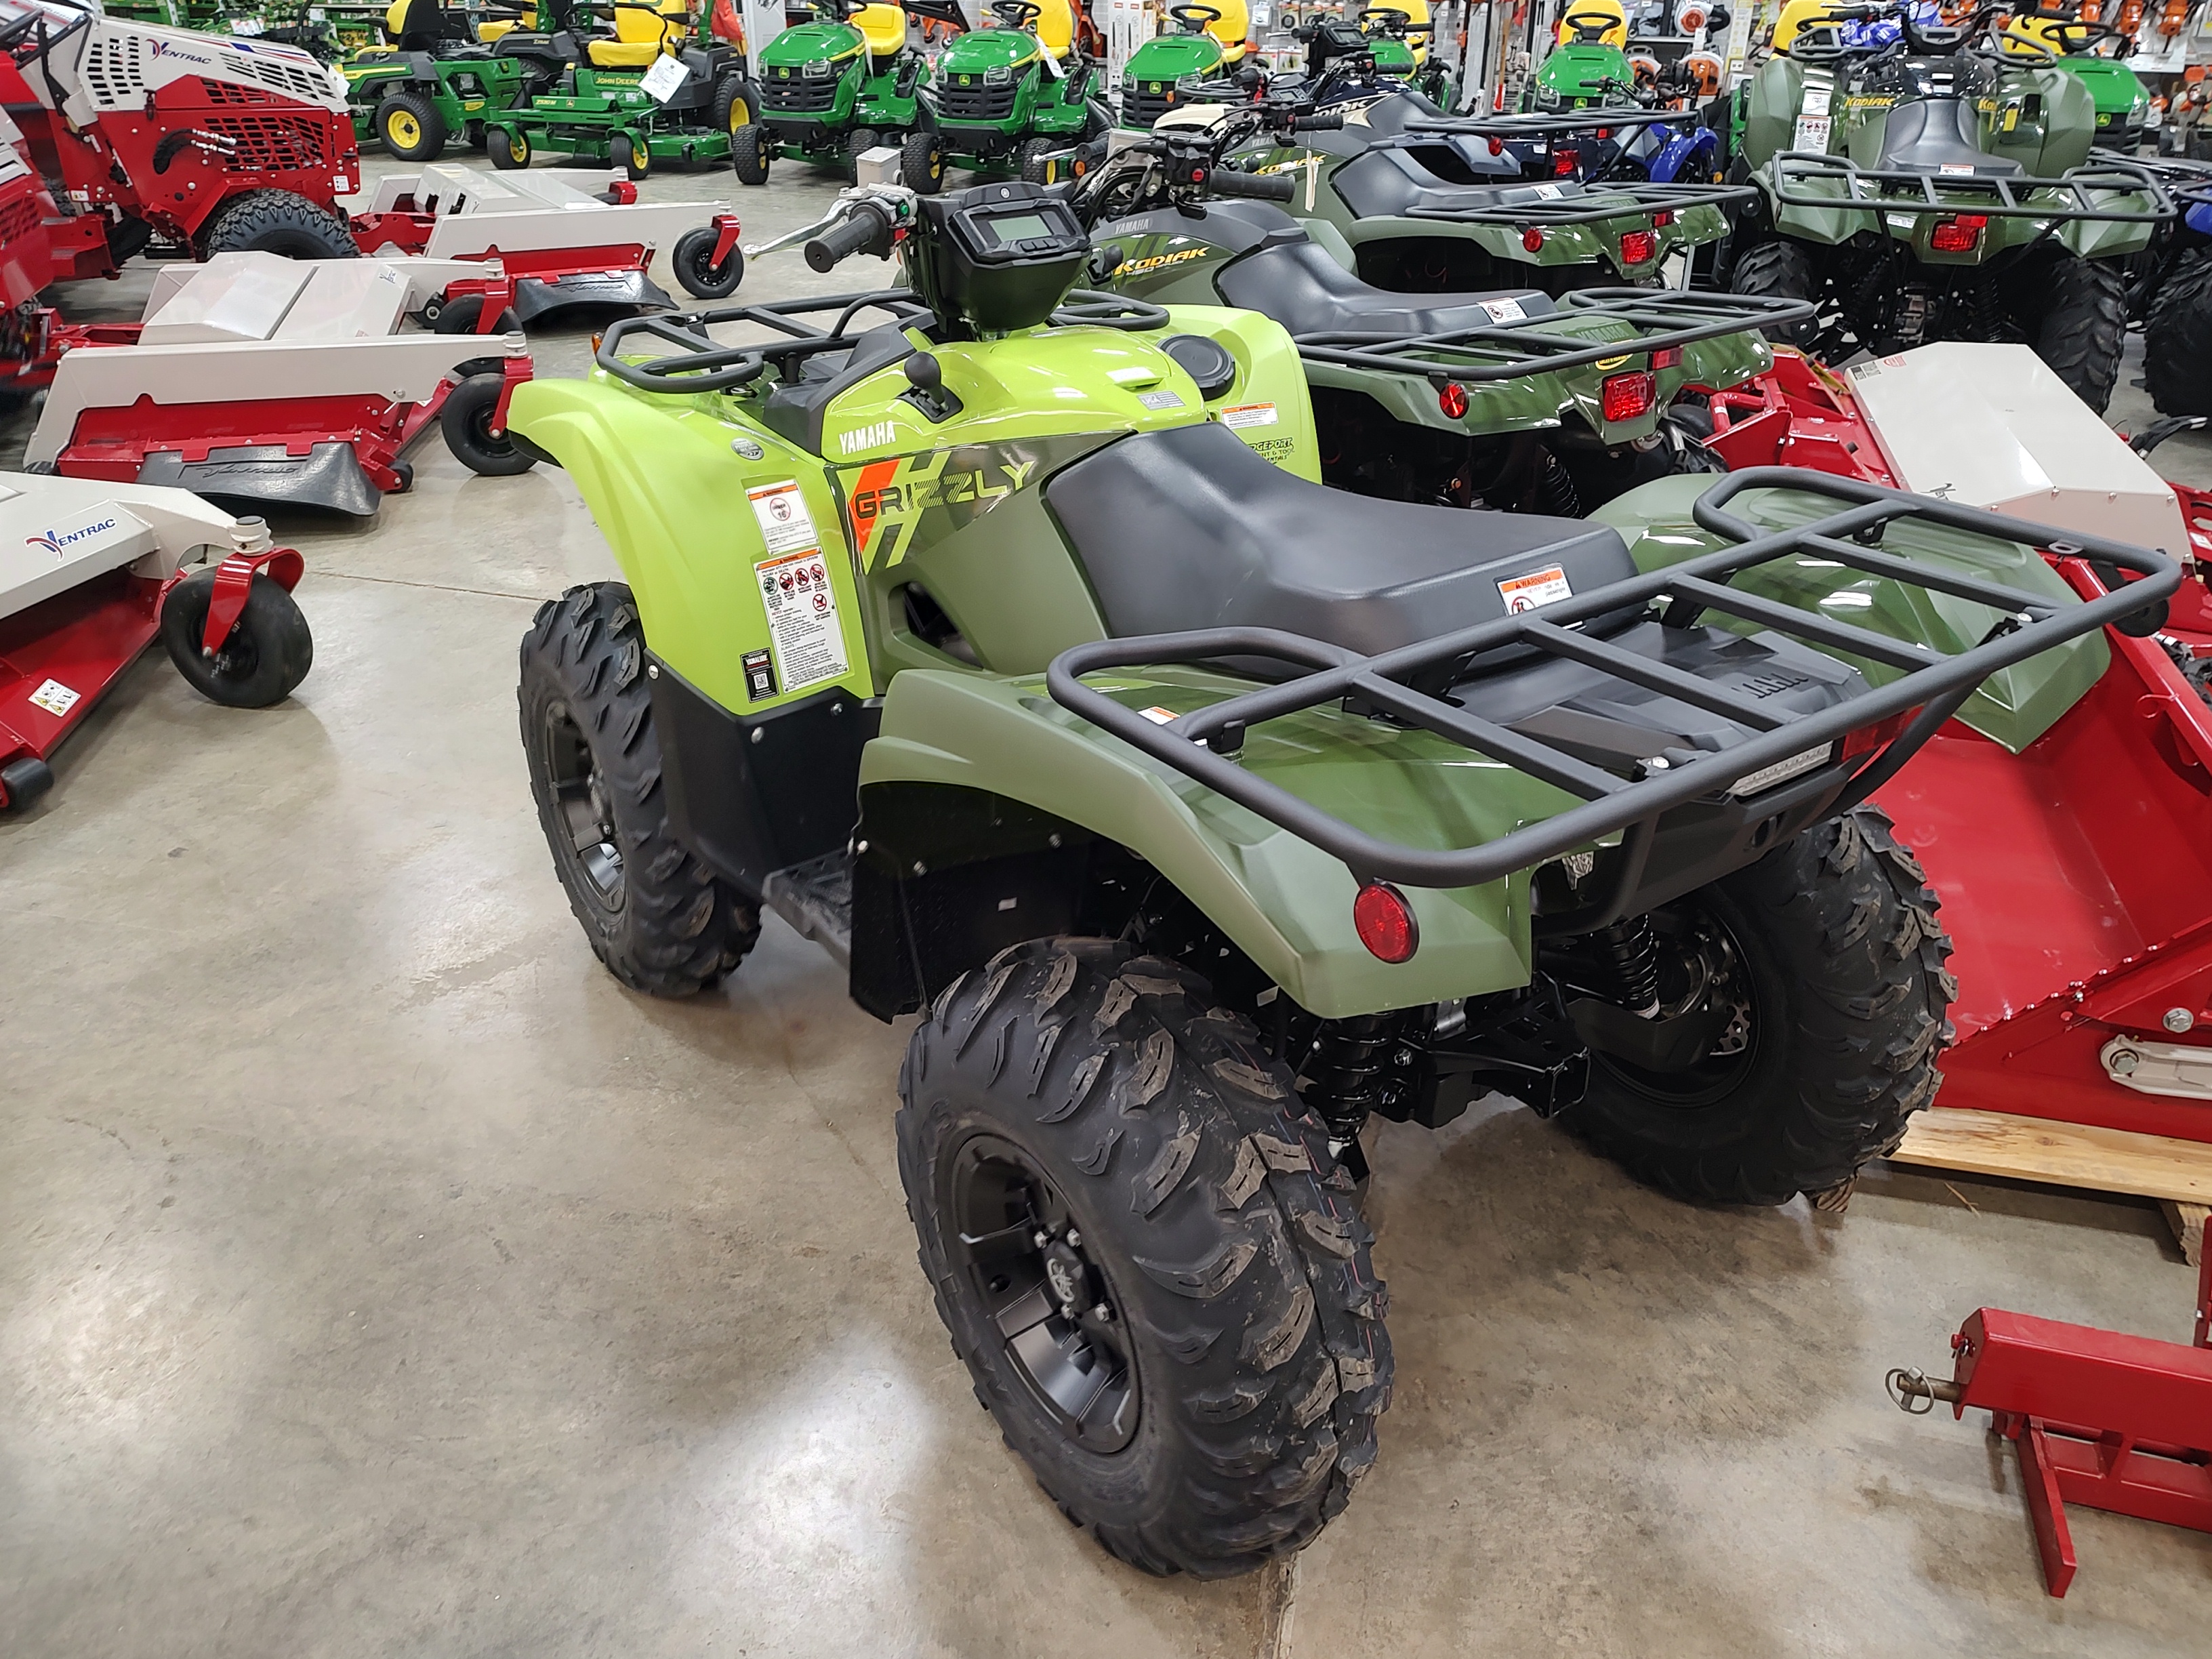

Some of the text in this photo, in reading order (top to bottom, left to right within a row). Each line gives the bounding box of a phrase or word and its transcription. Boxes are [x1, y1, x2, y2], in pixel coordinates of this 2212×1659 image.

[146, 39, 211, 64] VENTRAC
[596, 77, 639, 85] JOHN DEERE
[1845, 97, 1896, 107] KODIAK
[1252, 137, 1276, 148] YAMAH
[1115, 218, 1149, 235] YAMAHA
[1113, 247, 1211, 276] KODIAK
[839, 419, 897, 455] YAMAHA
[855, 460, 1036, 519] GRIZZLY
[26, 518, 116, 560] VENTRAC
[1520, 574, 1551, 588] WARNING
